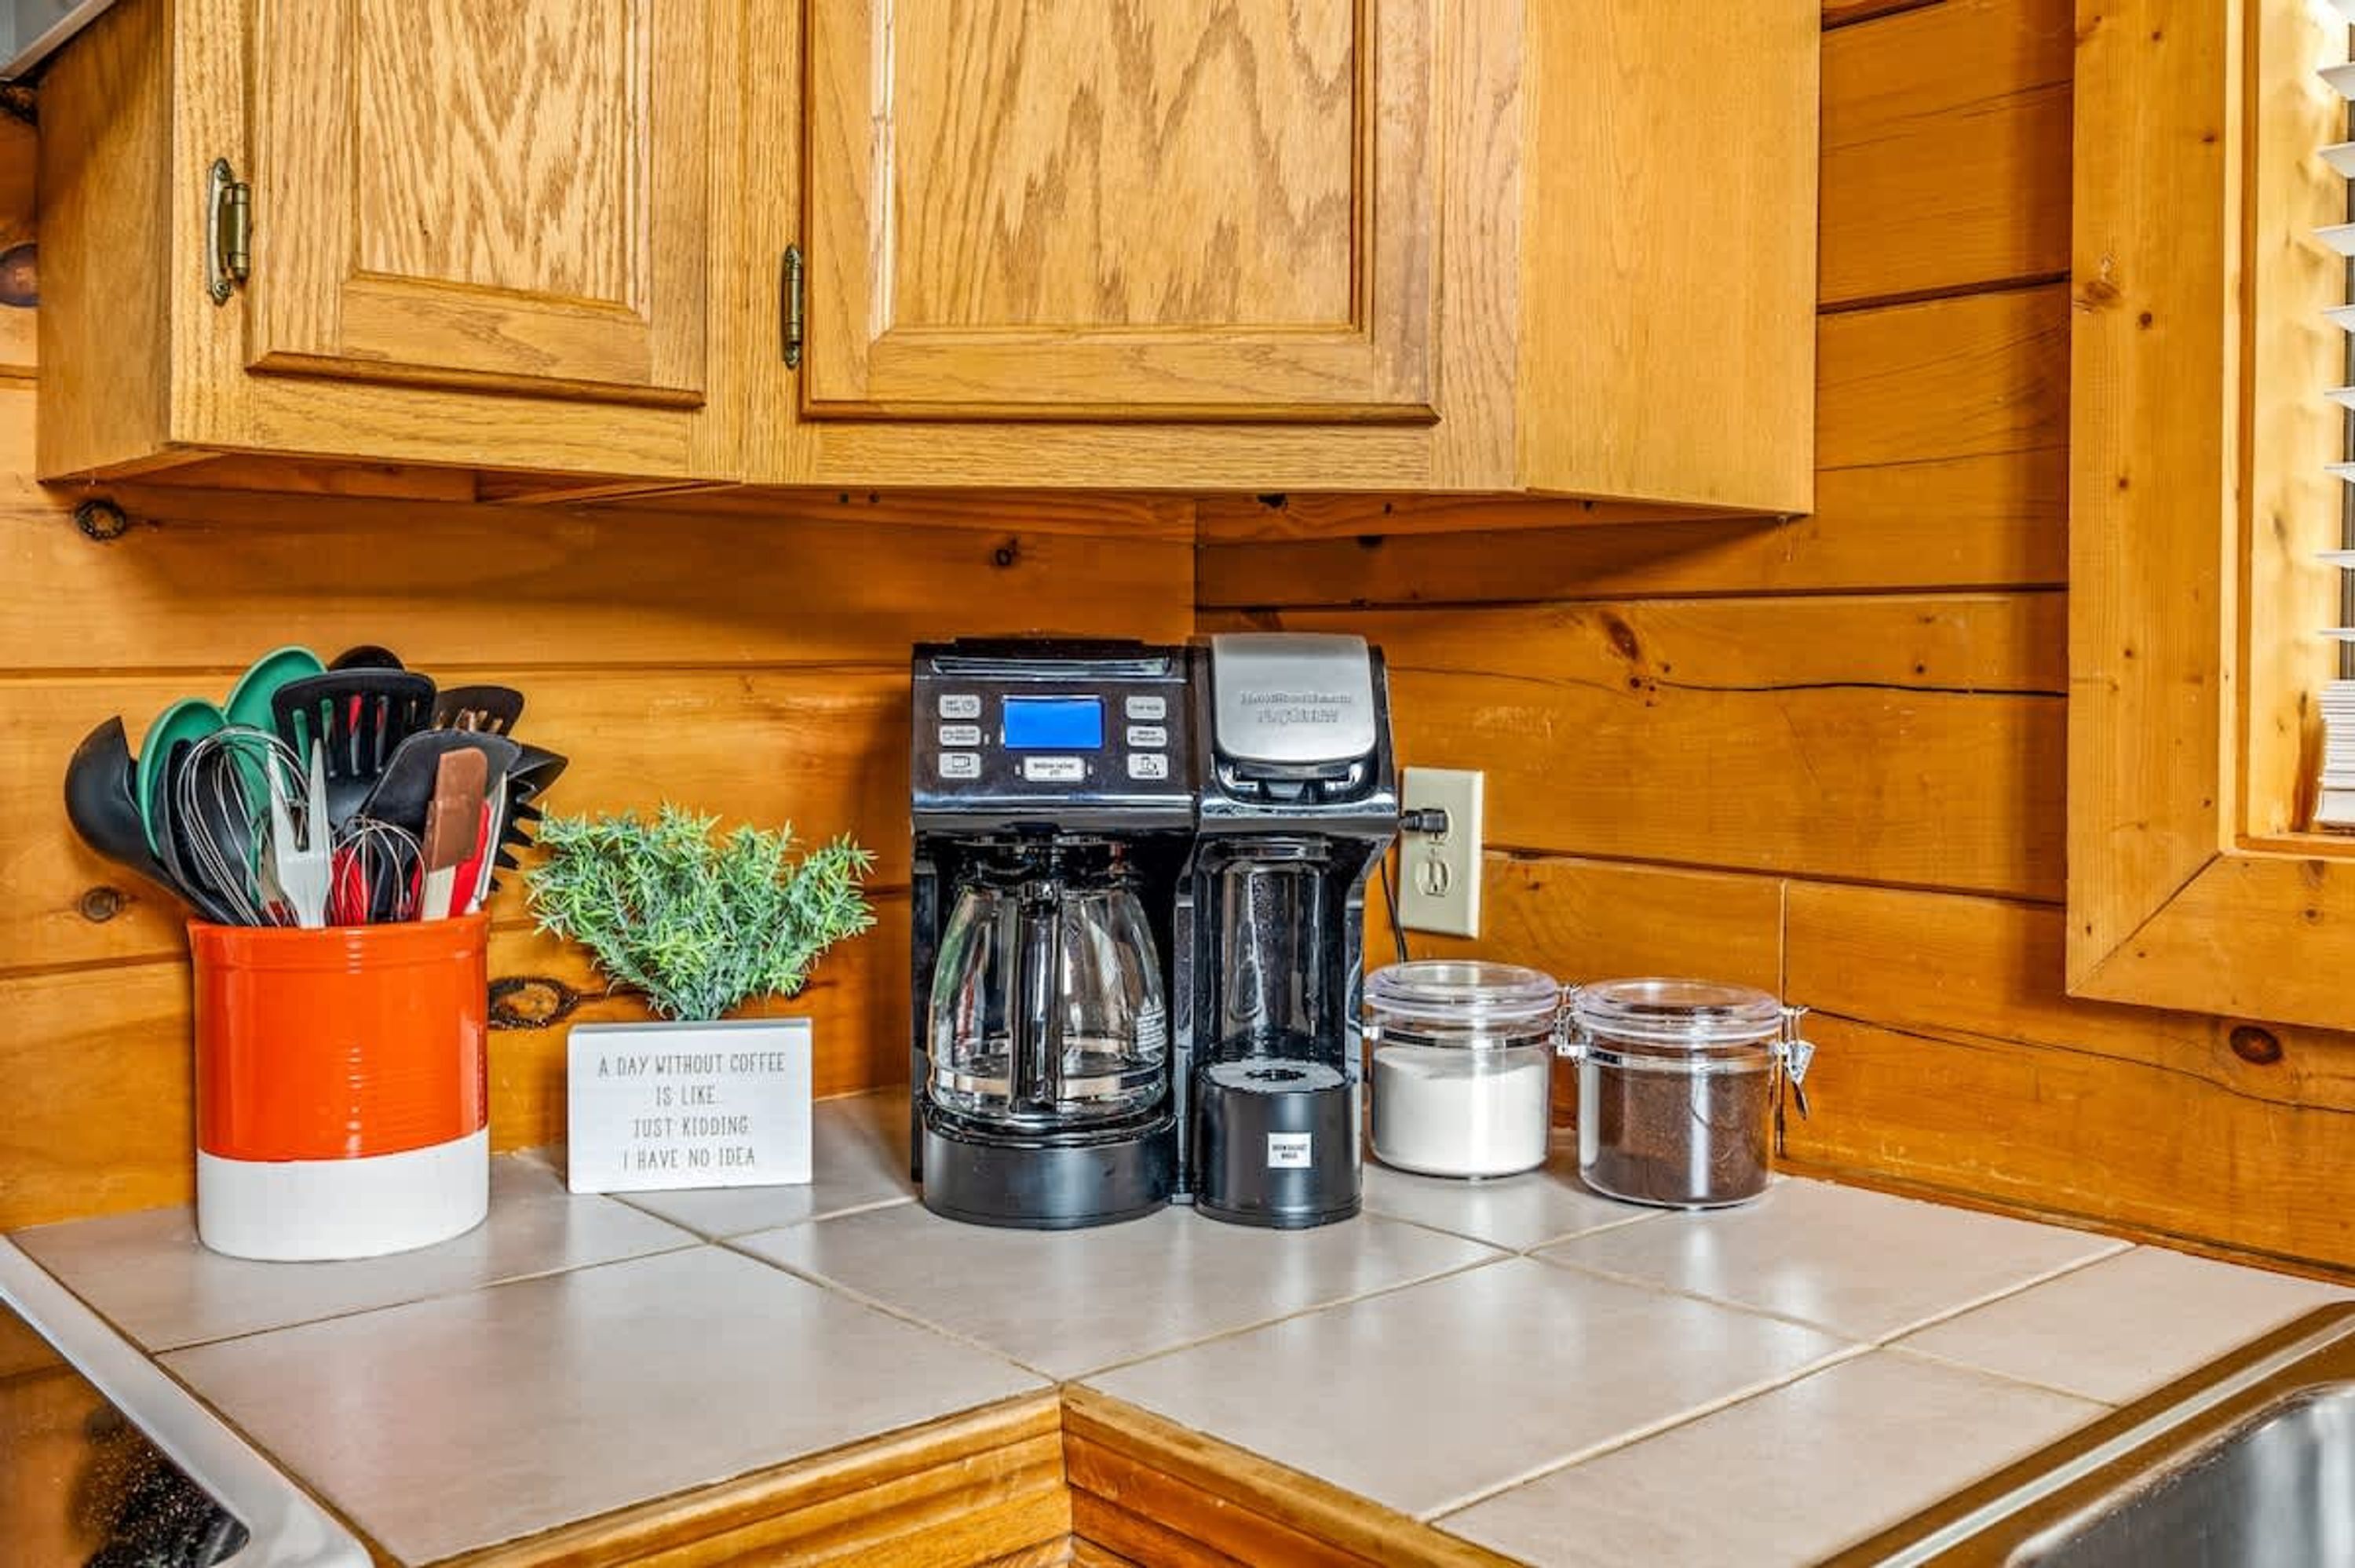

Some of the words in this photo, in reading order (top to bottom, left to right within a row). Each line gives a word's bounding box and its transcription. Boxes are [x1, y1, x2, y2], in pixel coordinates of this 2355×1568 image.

[598, 1055, 610, 1078] A
[617, 1055, 648, 1076] DAY
[655, 1053, 722, 1075] WITHOUT
[730, 1051, 786, 1073] COFFEE
[656, 1085, 673, 1107] IS
[633, 1118, 672, 1138] JUST
[683, 1115, 749, 1136] KIDDING
[637, 1148, 678, 1170] HAVE
[688, 1147, 710, 1168] NO
[719, 1146, 756, 1166] IDEA
